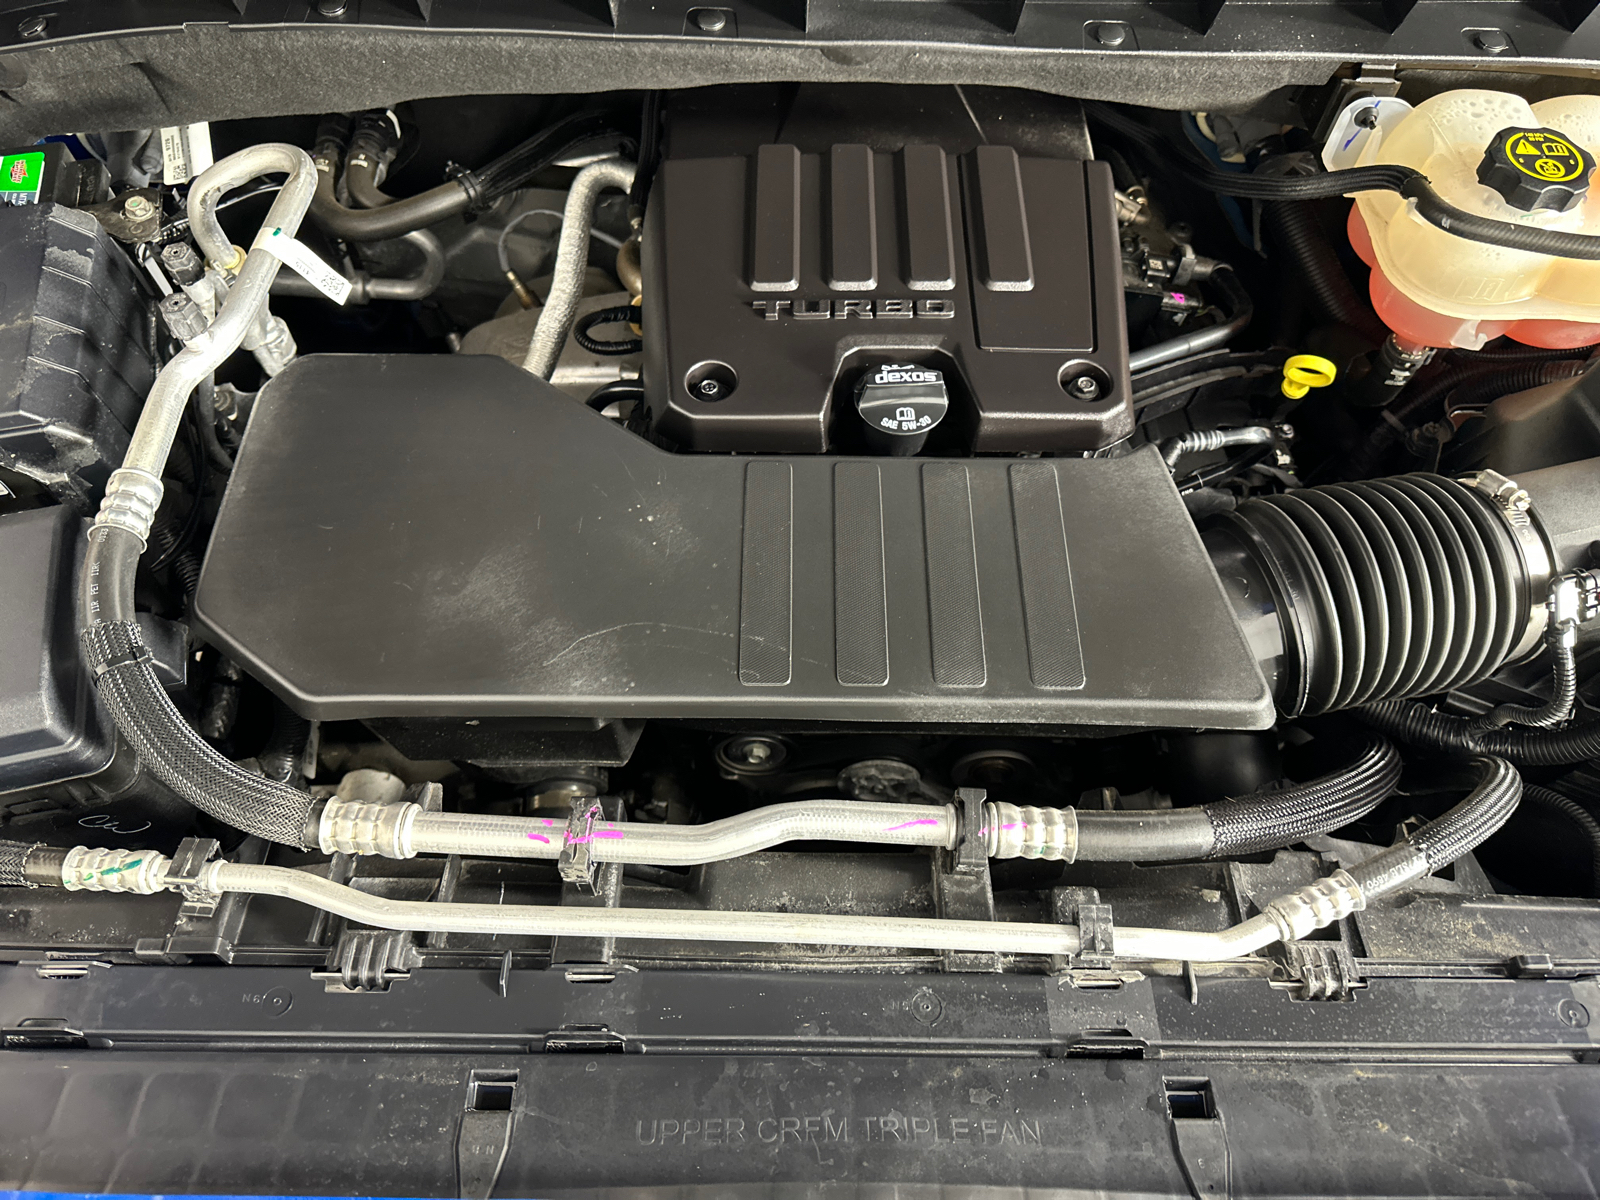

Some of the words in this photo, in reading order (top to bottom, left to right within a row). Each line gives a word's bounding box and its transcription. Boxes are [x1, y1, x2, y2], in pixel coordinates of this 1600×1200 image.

[752, 300, 955, 321] TURBO
[875, 370, 938, 384] dexos
[880, 416, 898, 430] SAE
[902, 415, 932, 431] 5W-30
[90, 583, 99, 596] PET
[635, 1116, 746, 1146] UPPER
[757, 1116, 848, 1144] CRFM
[862, 1115, 970, 1144] TRIPLE
[981, 1117, 1043, 1147] FAN
